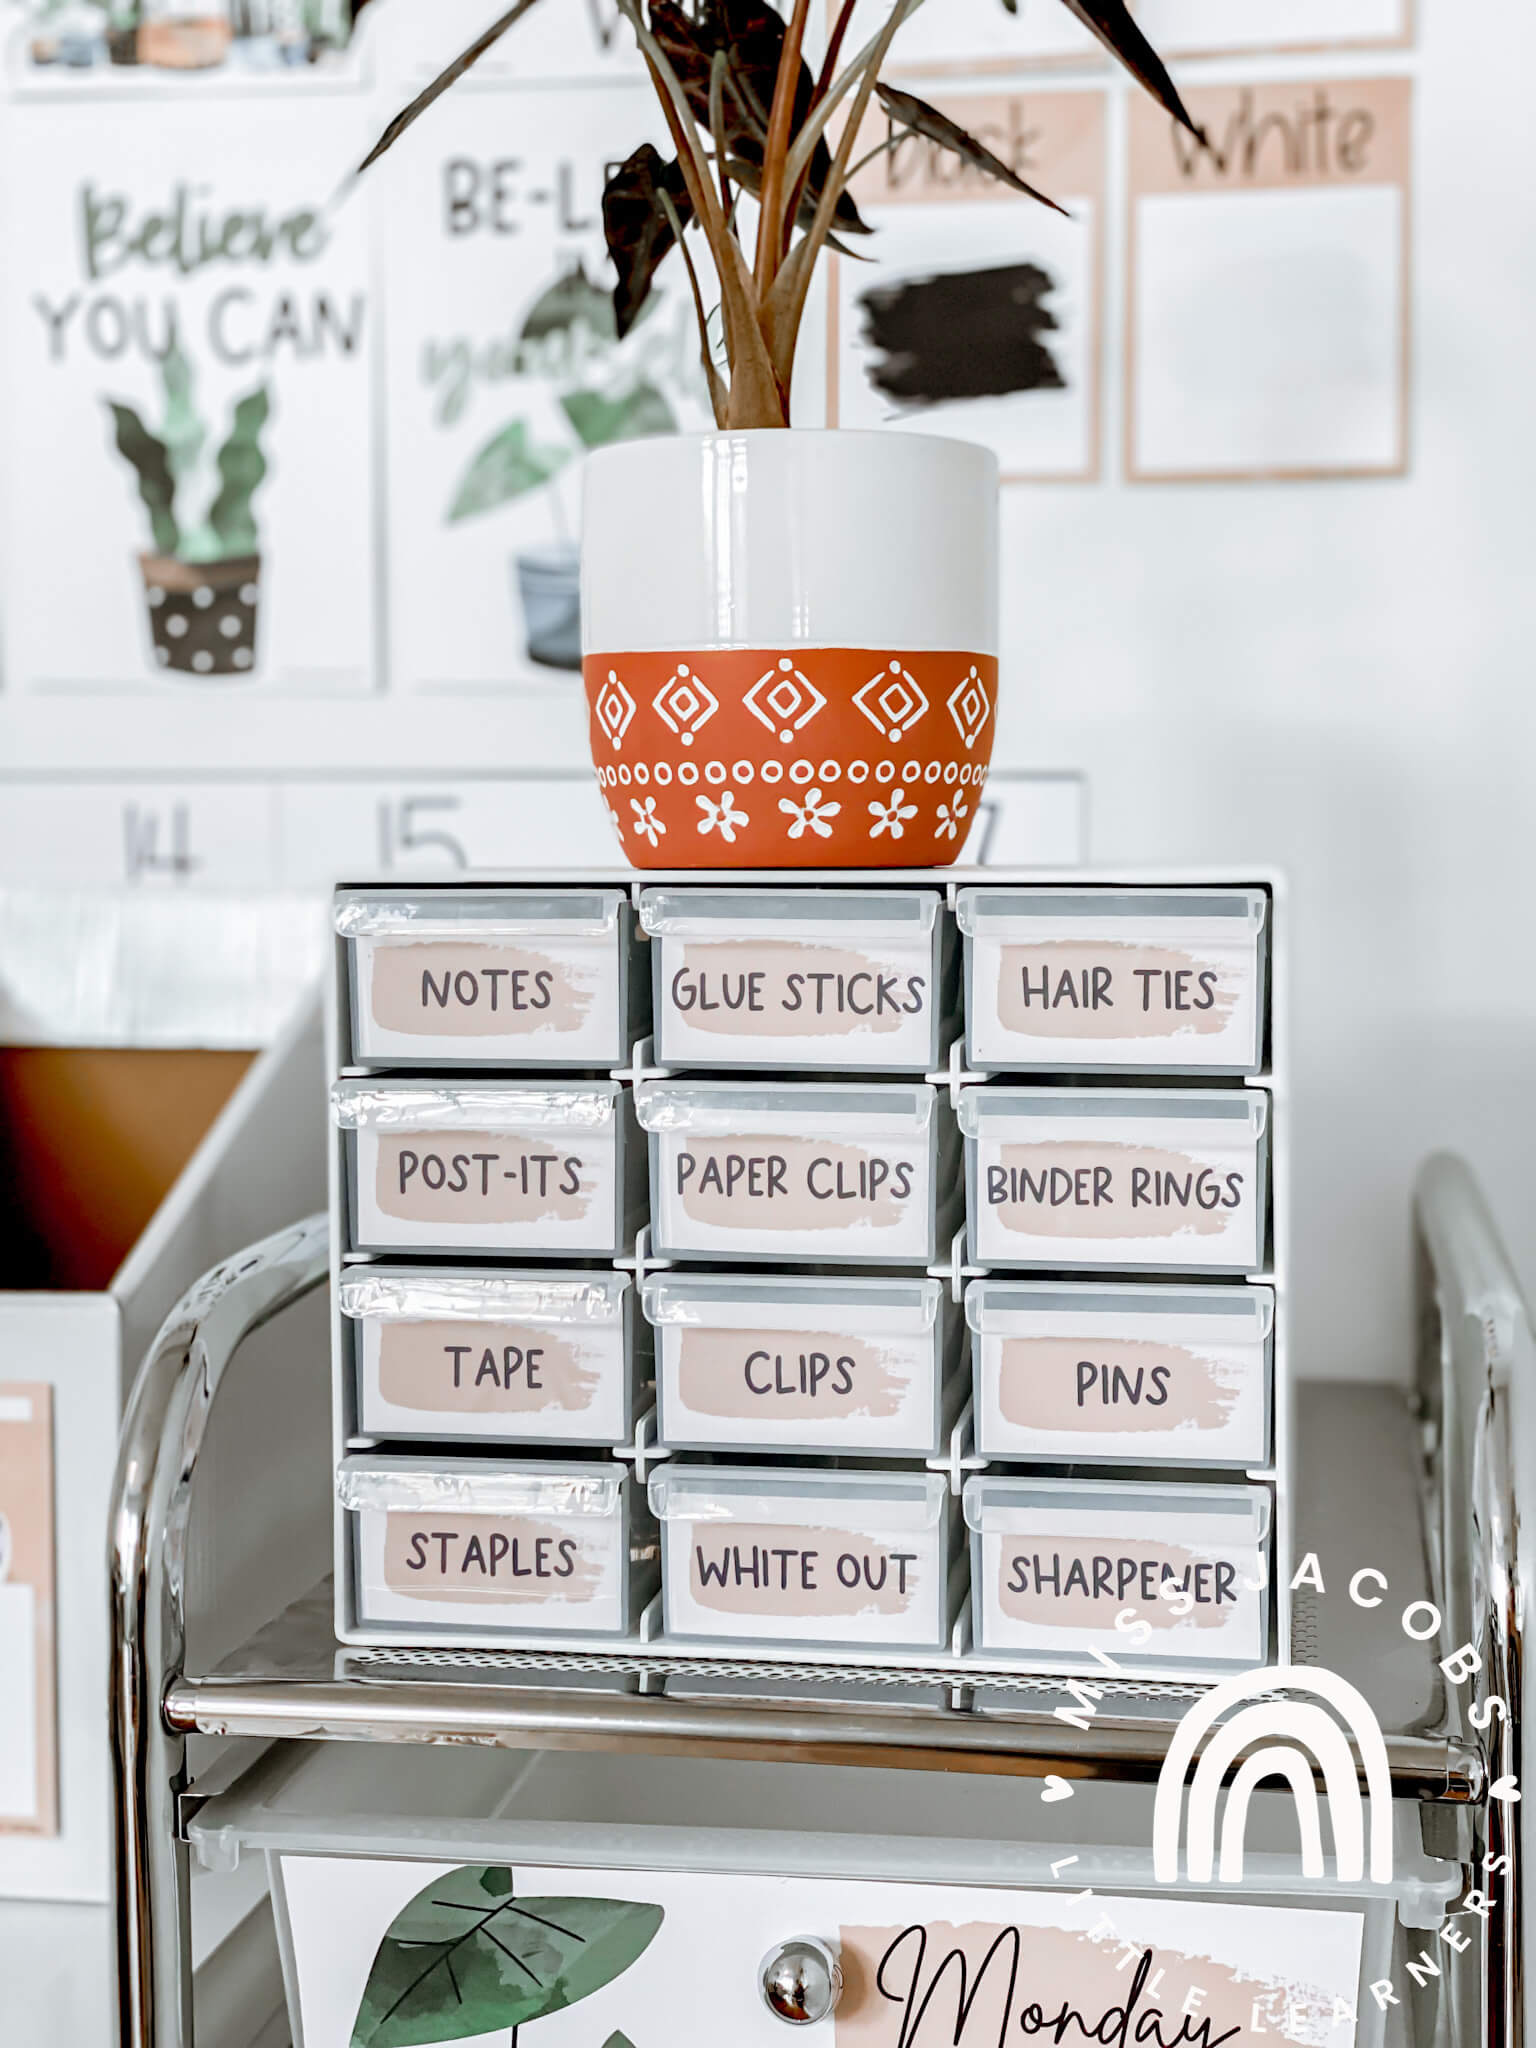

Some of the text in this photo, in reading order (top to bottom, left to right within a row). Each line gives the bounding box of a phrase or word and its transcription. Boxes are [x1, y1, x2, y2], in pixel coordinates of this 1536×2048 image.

[78, 179, 328, 280] Believe
[36, 293, 180, 363] YOU
[207, 288, 364, 364] CAN
[421, 968, 554, 1012] NOTES
[671, 967, 926, 1016] GLUE STICKS
[1021, 964, 1218, 1012] HAIR TIES
[398, 1150, 583, 1198] POST-ITS
[677, 1152, 914, 1202] PAPER CLIPS
[987, 1165, 1244, 1210] BINDER RINGS
[443, 1345, 545, 1391] TAPE
[744, 1350, 856, 1398] CLIPS
[1076, 1361, 1171, 1407] PINS
[405, 1531, 577, 1578] STAPLES
[695, 1544, 918, 1595] WHITE OUT
[1007, 1553, 1237, 1605] SHARPENER
[876, 1924, 1242, 2048] Monday
